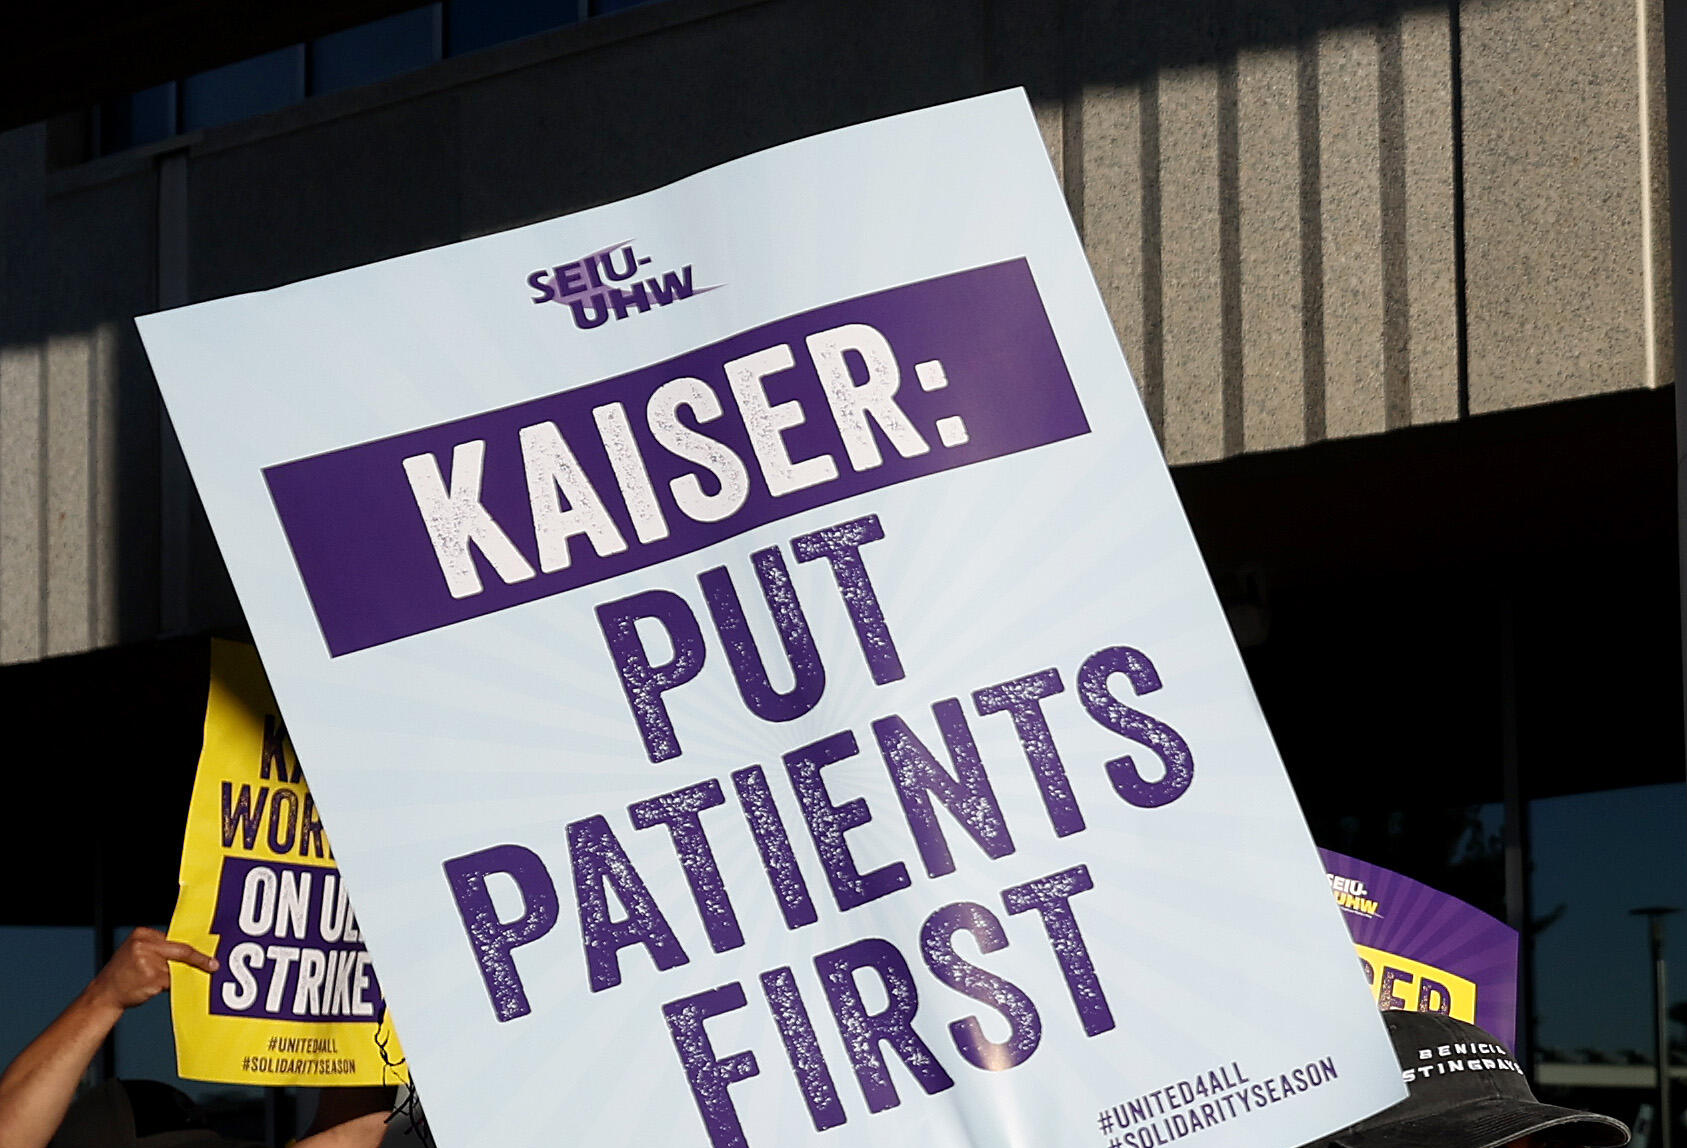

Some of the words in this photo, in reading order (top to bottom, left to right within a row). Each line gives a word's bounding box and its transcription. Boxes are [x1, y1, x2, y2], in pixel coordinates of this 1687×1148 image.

[527, 243, 653, 307] SEIU-
[568, 263, 696, 331] UHW
[403, 321, 970, 599] KAISER:
[596, 514, 905, 763] PUT
[443, 646, 1195, 1022] PATIENTS
[238, 866, 309, 939] ON
[319, 874, 365, 944] UL
[221, 940, 375, 1017] STRIKE
[241, 1056, 356, 1075] #SOLIDARITYSEASON
[267, 1036, 338, 1054] #UNITED4ALL
[1098, 1062, 1250, 1134] #UNITED4ALL
